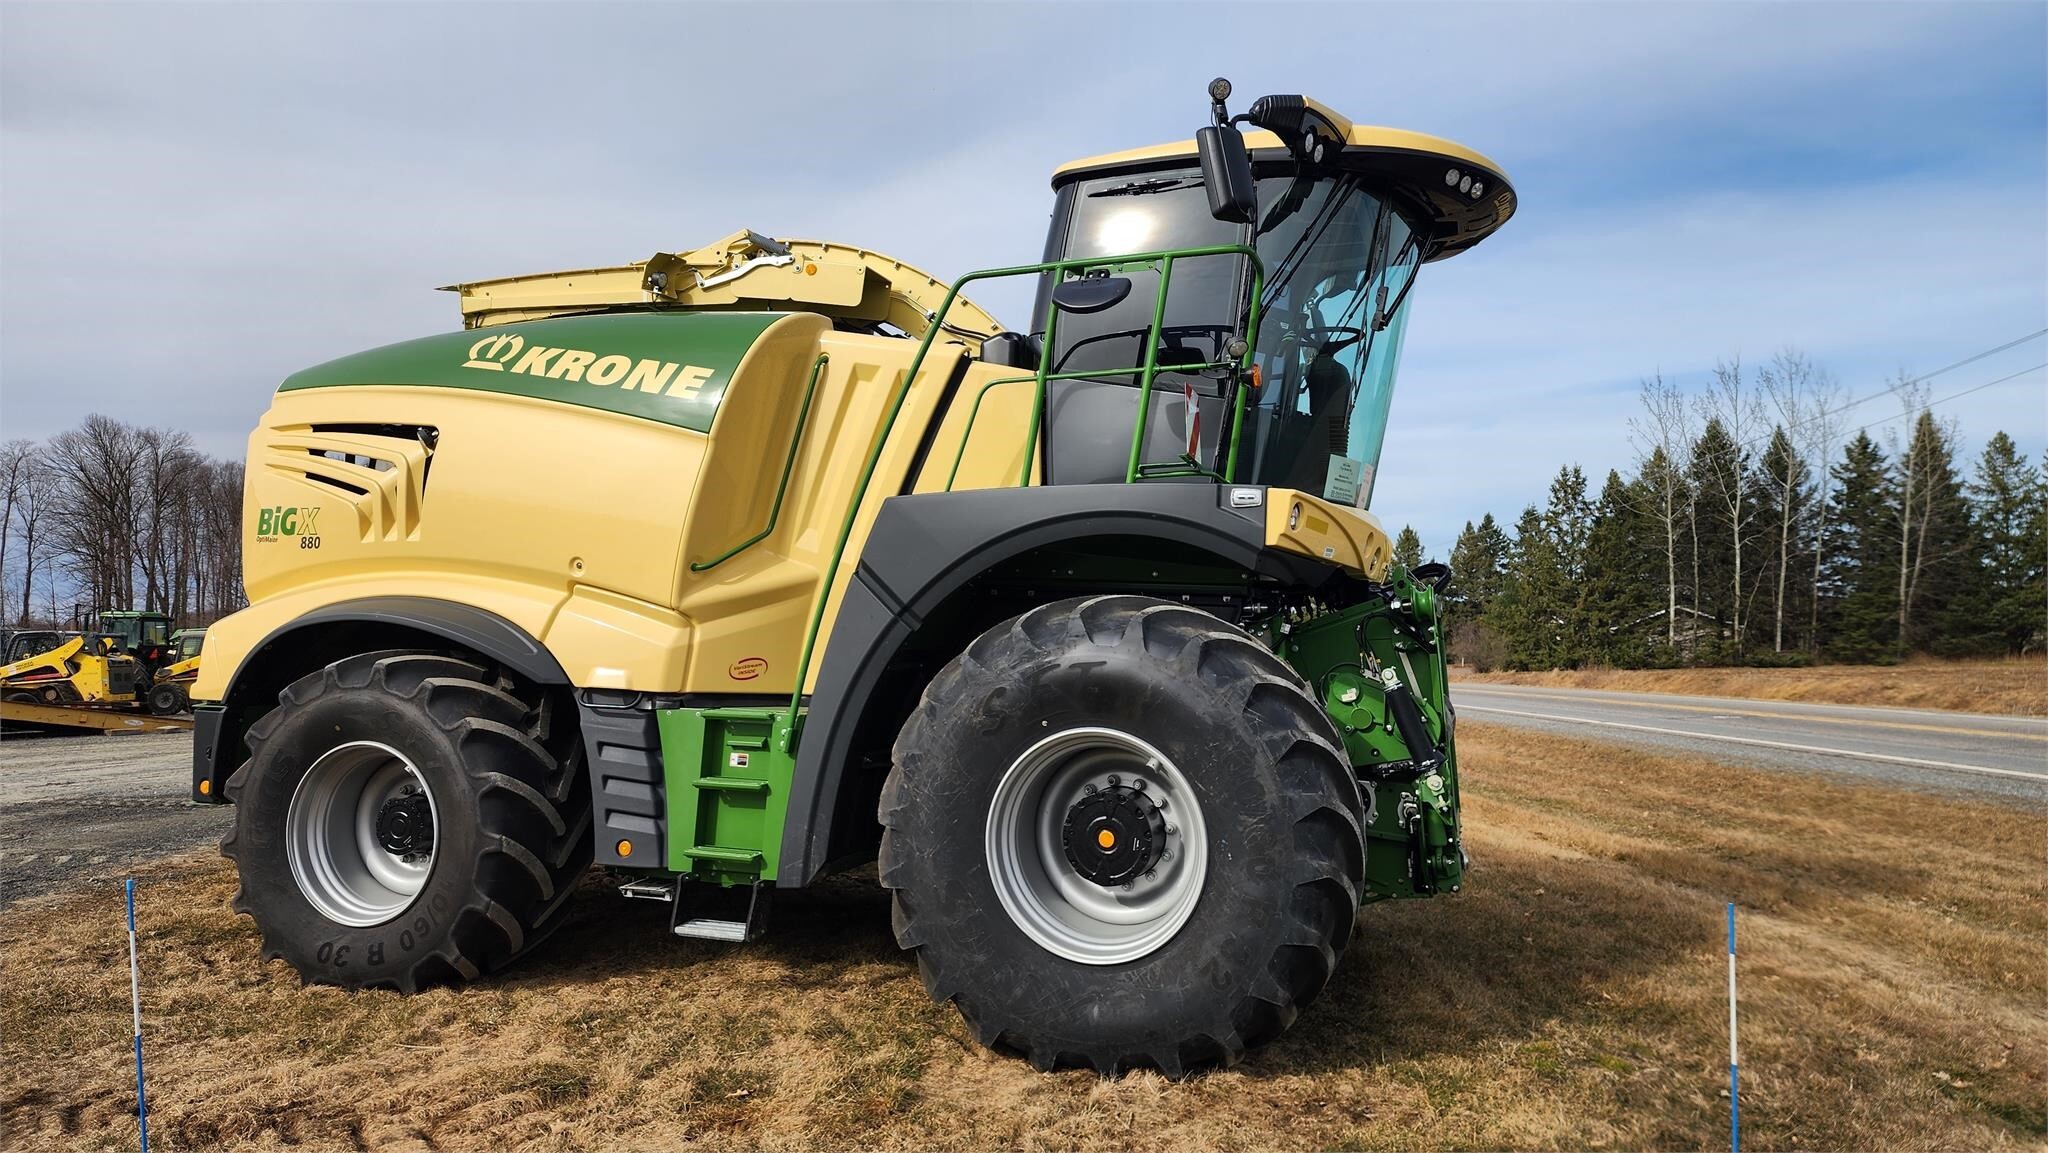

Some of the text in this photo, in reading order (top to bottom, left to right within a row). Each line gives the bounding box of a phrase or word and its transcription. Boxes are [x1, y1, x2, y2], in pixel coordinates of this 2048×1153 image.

[510, 345, 715, 399] KRONE
[300, 536, 321, 549] 880
[317, 942, 351, 968] 30
[367, 942, 385, 966] R
